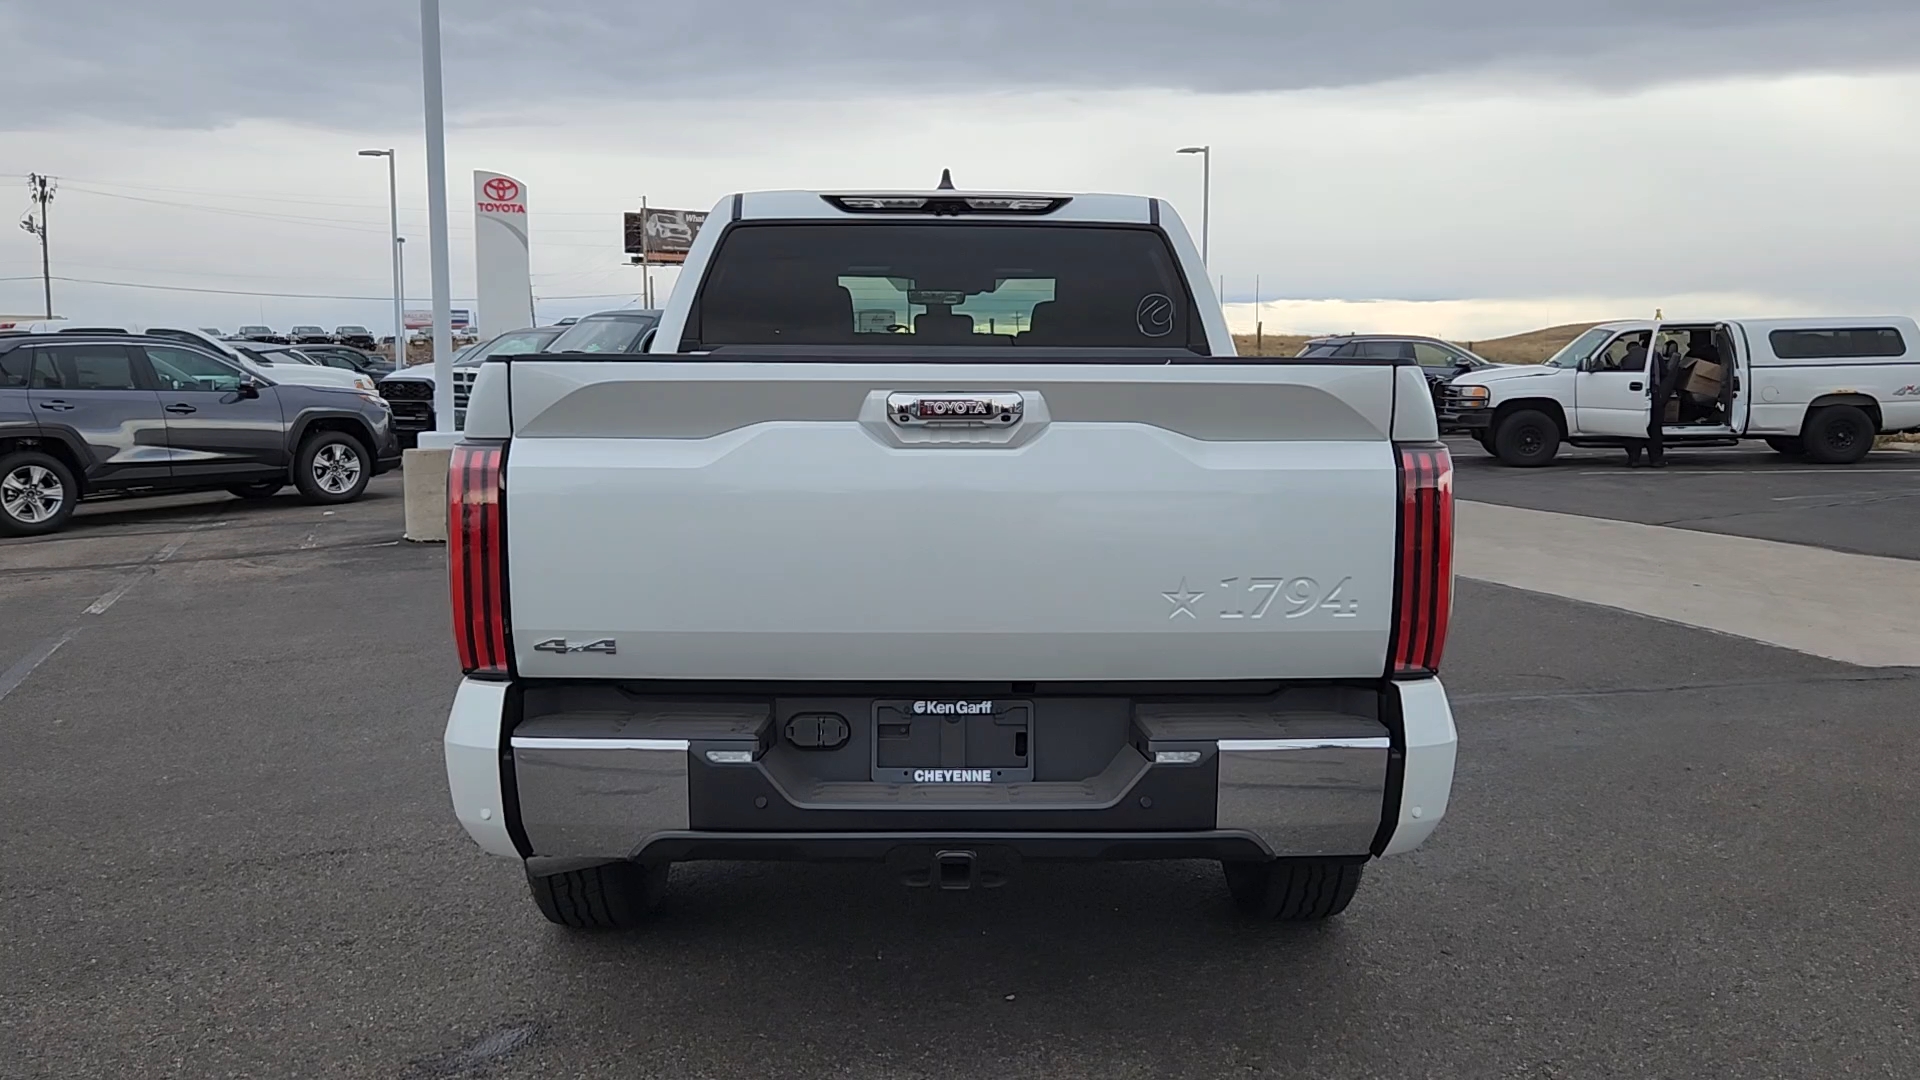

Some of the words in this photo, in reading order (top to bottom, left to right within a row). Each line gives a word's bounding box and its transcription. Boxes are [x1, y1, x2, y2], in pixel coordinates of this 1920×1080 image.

[477, 202, 526, 213] TOYOTA
[924, 401, 987, 414] TOYOTA
[1219, 576, 1358, 618] 1794
[927, 700, 955, 714] Ken
[955, 700, 992, 714] Garff
[914, 769, 992, 782] CHEYENNE
